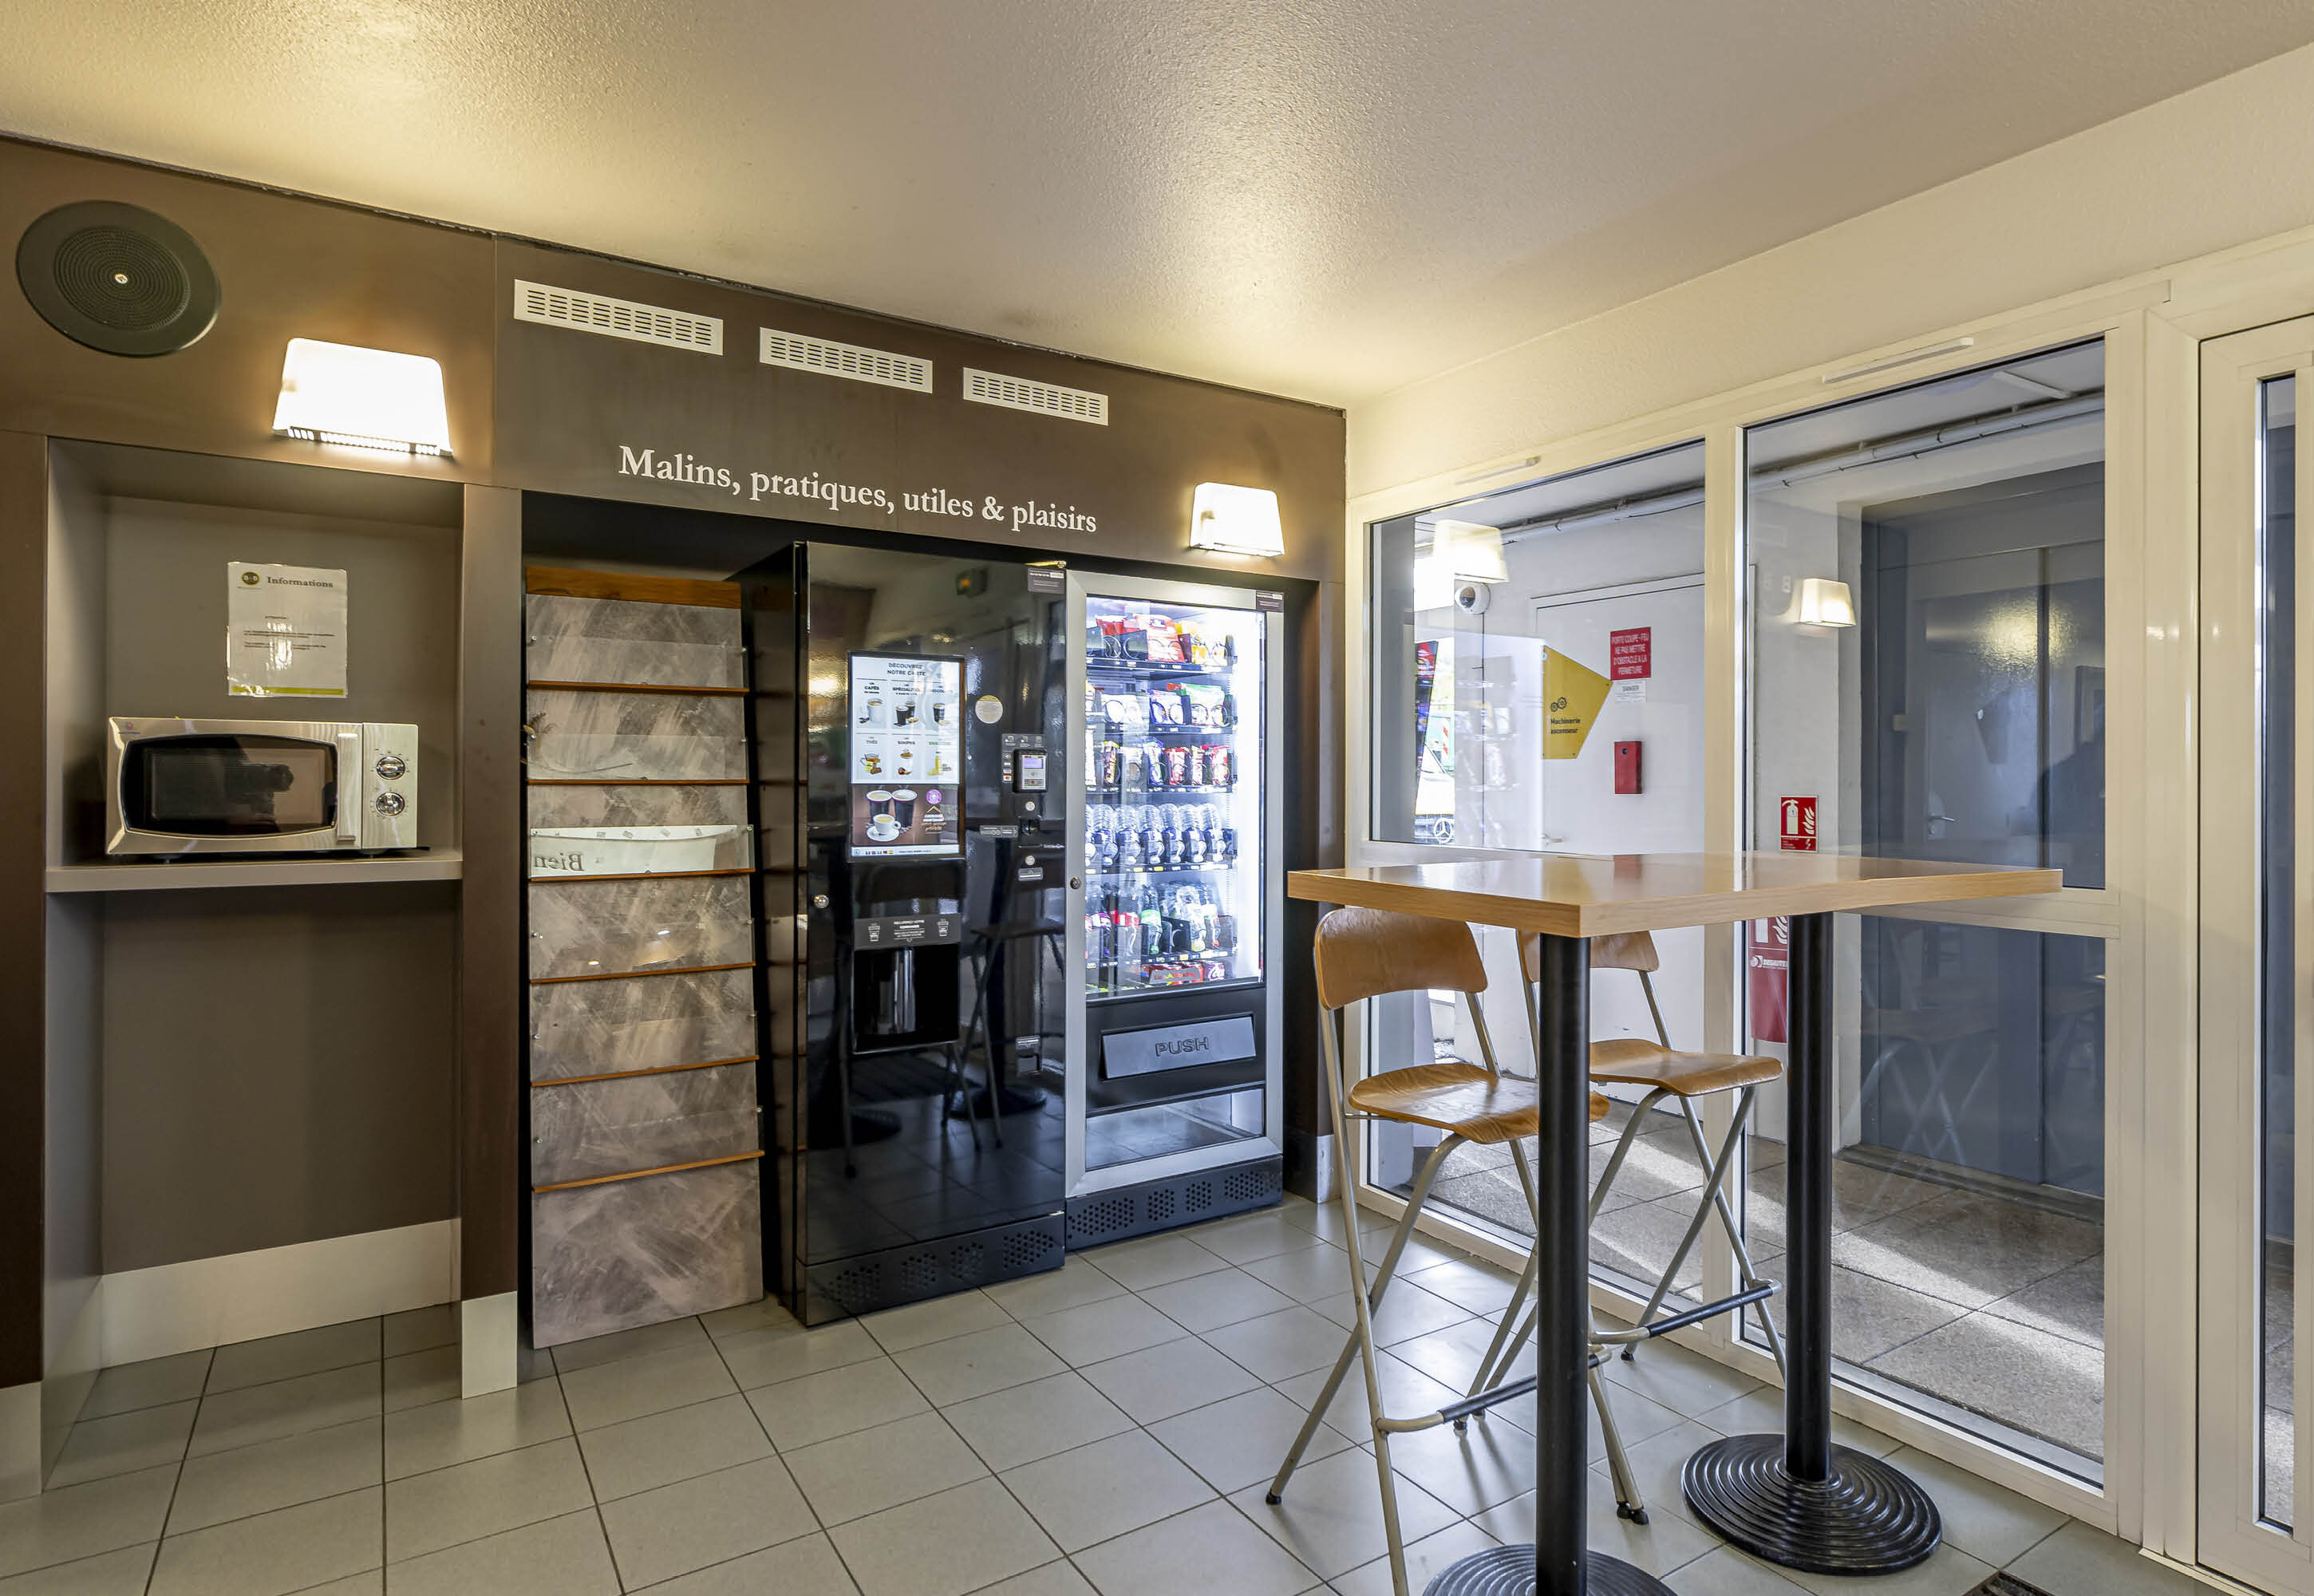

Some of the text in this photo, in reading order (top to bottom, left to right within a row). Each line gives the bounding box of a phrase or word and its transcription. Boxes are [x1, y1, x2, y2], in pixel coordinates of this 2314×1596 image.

[618, 444, 1097, 533] Malins, pratiques, utiles & plaisirs
[267, 576, 334, 588] Informations
[1155, 1037, 1210, 1057] PUSH
